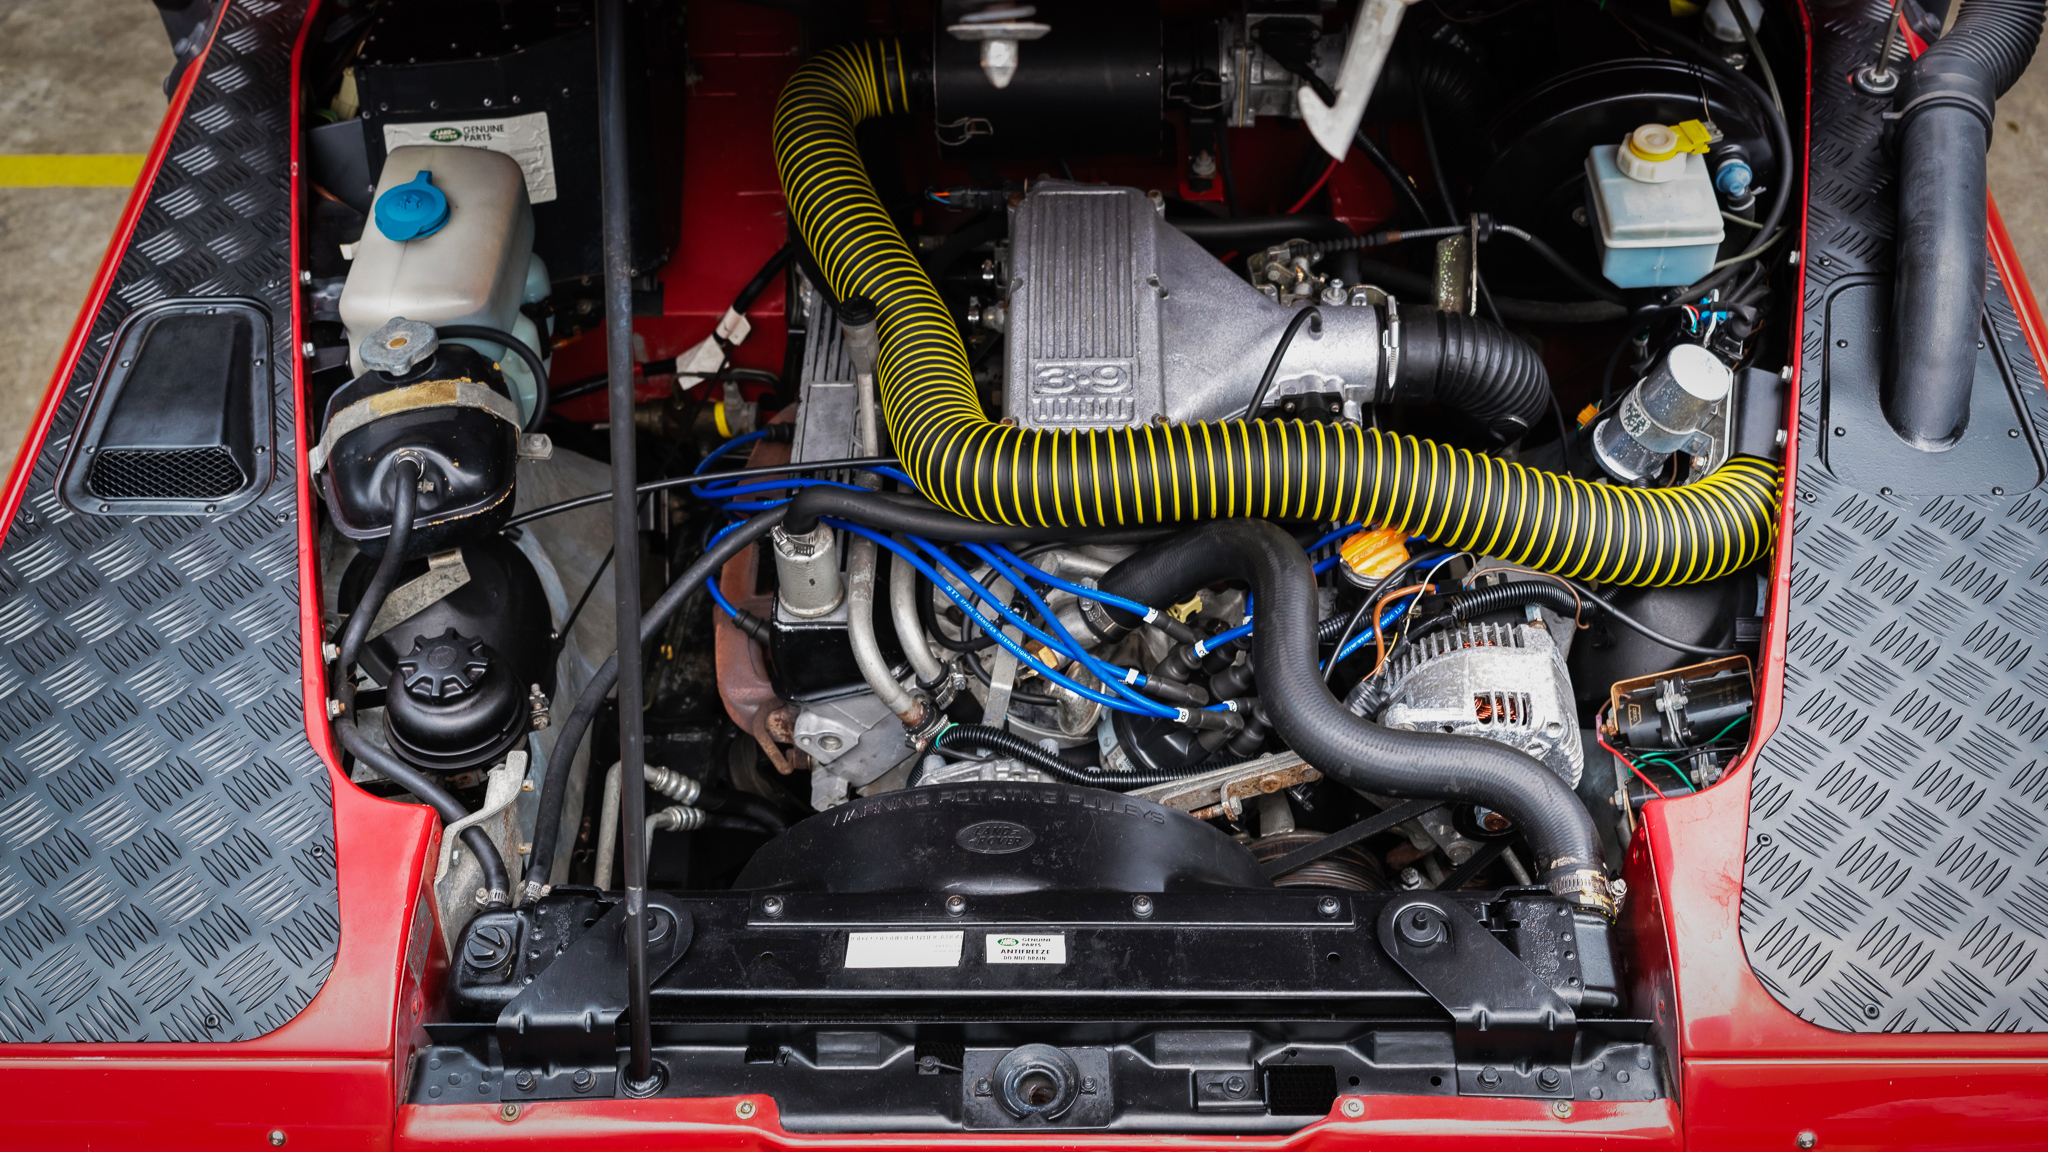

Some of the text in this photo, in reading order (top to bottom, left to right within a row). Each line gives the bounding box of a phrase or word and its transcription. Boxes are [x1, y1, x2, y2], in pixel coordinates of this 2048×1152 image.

[463, 124, 504, 134] GENUINE
[463, 133, 492, 141] PARTS
[946, 585, 960, 599] STI
[960, 599, 974, 613] SPARK
[974, 613, 997, 633] TRANSFER
[997, 632, 1033, 663] INTERNATIONAL
[1066, 793, 1165, 825] PULLEYS
